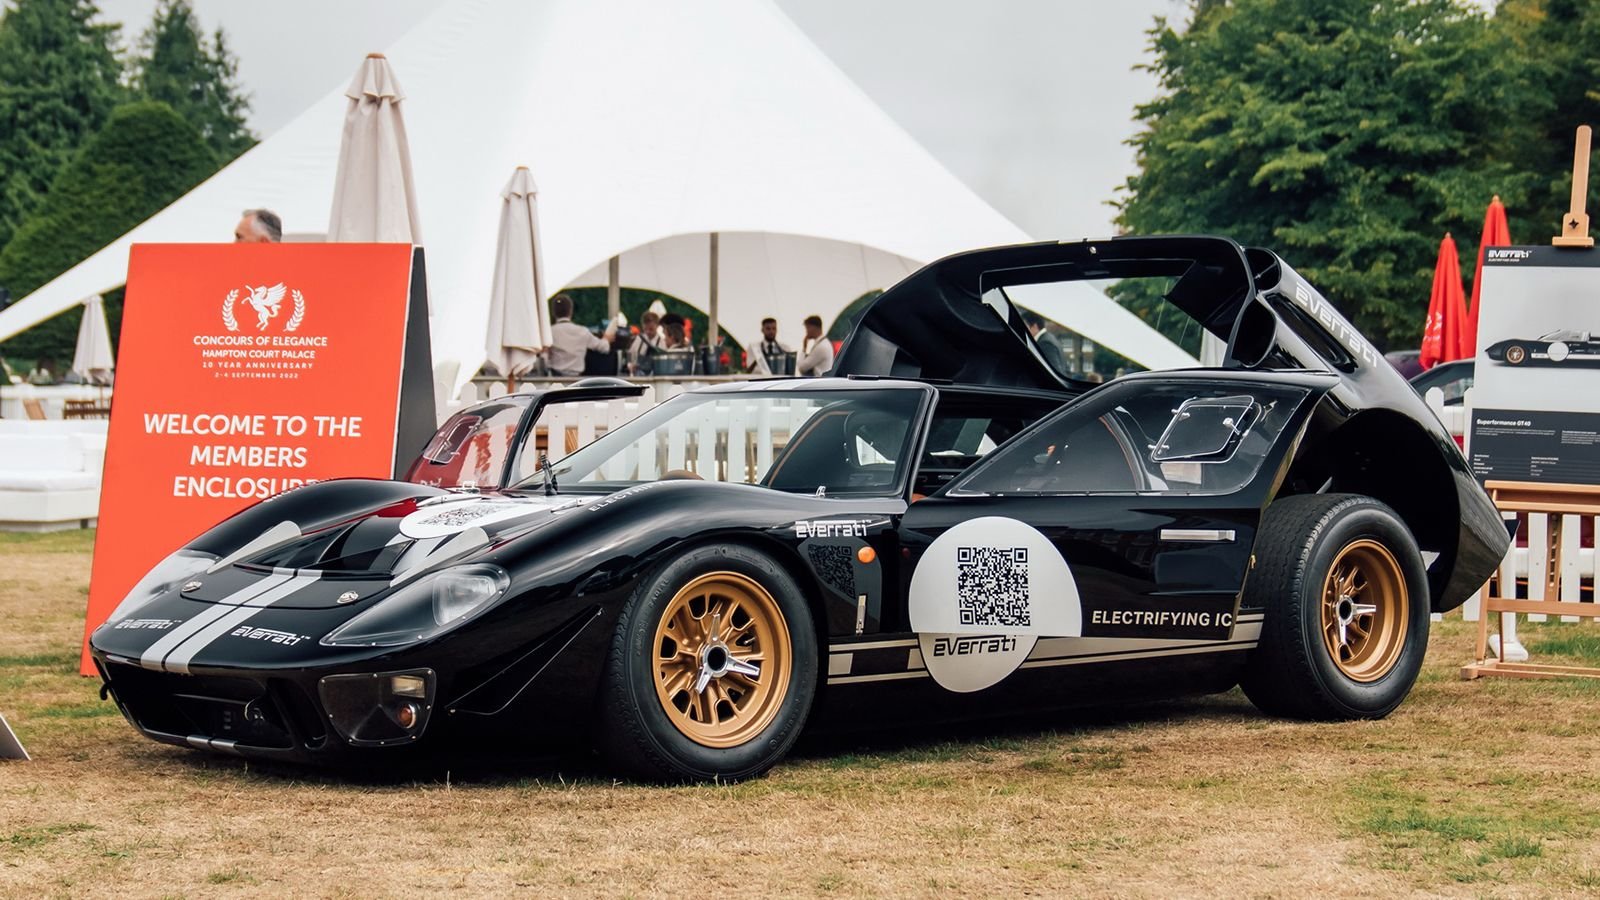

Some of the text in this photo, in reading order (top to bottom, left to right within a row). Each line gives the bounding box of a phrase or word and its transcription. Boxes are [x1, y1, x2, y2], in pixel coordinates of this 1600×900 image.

[193, 335, 328, 347] CONCOURS OF ELEGANCE
[202, 349, 316, 360] HAMPTON COURT PALACE
[202, 361, 313, 370] 10 YEAR ANNIVERSARY
[143, 413, 363, 437] WELCOME TO THE
[189, 445, 308, 468] MEMBERS
[173, 476, 319, 499] ENCLOSU
[1091, 610, 1233, 627] ELECTRIFYING IC
